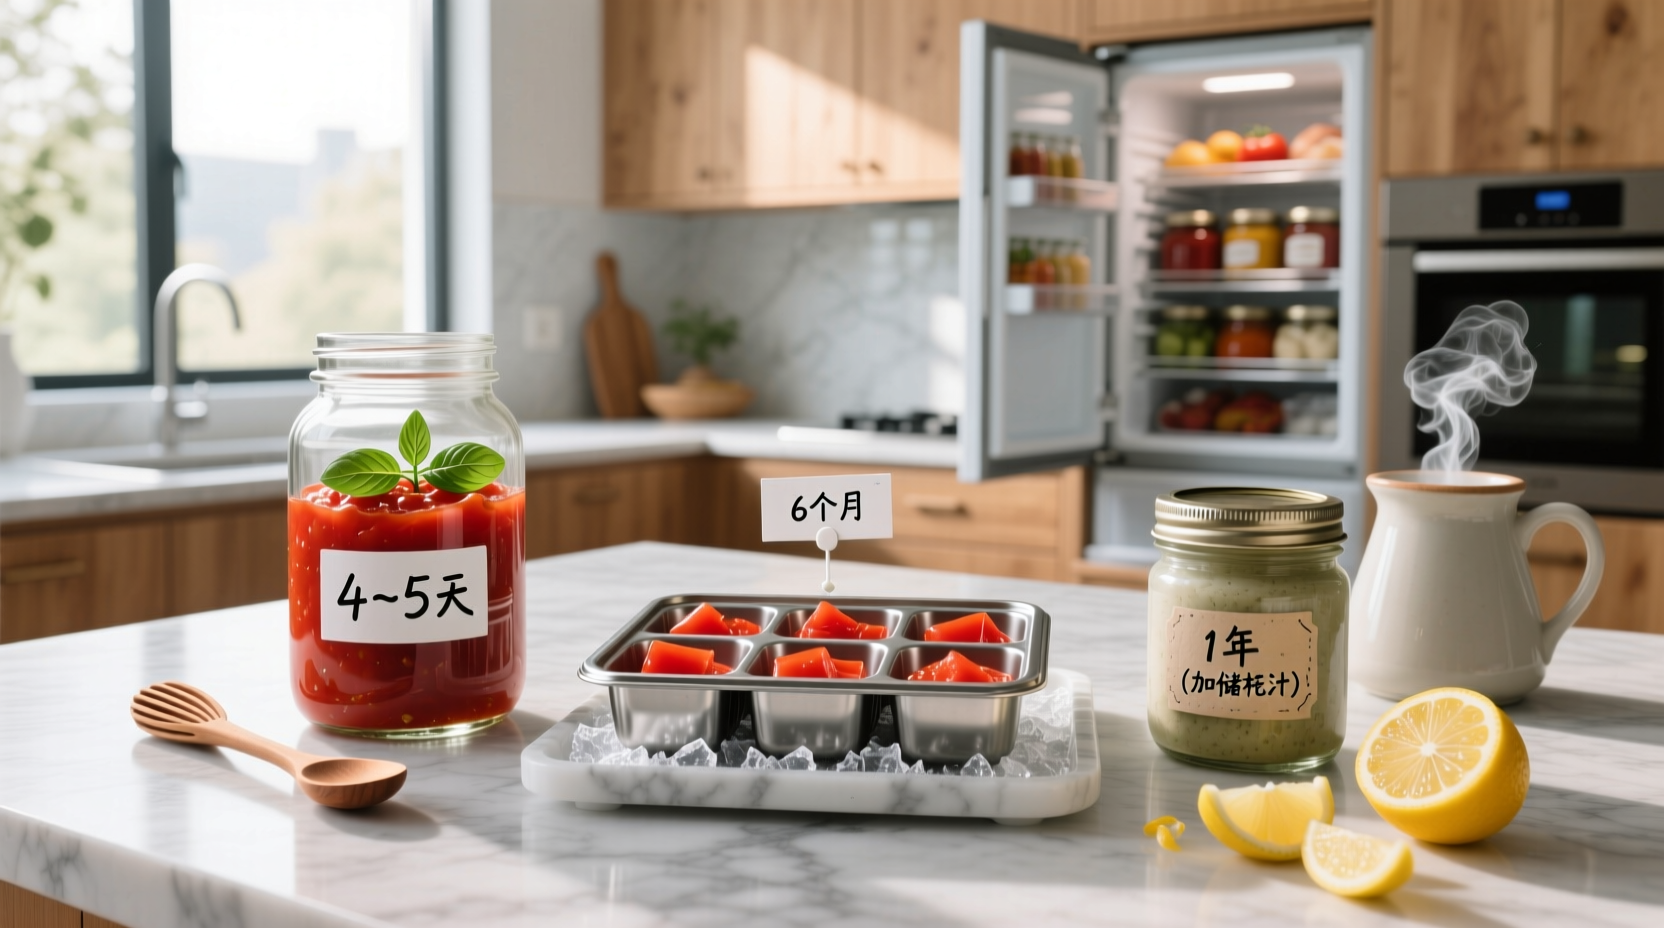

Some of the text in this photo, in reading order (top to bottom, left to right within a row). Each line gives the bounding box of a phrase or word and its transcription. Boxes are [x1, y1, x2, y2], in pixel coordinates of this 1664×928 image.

[791, 490, 862, 522] 6个月
[335, 572, 475, 622] 4~5天
[1204, 625, 1260, 668] 1年
